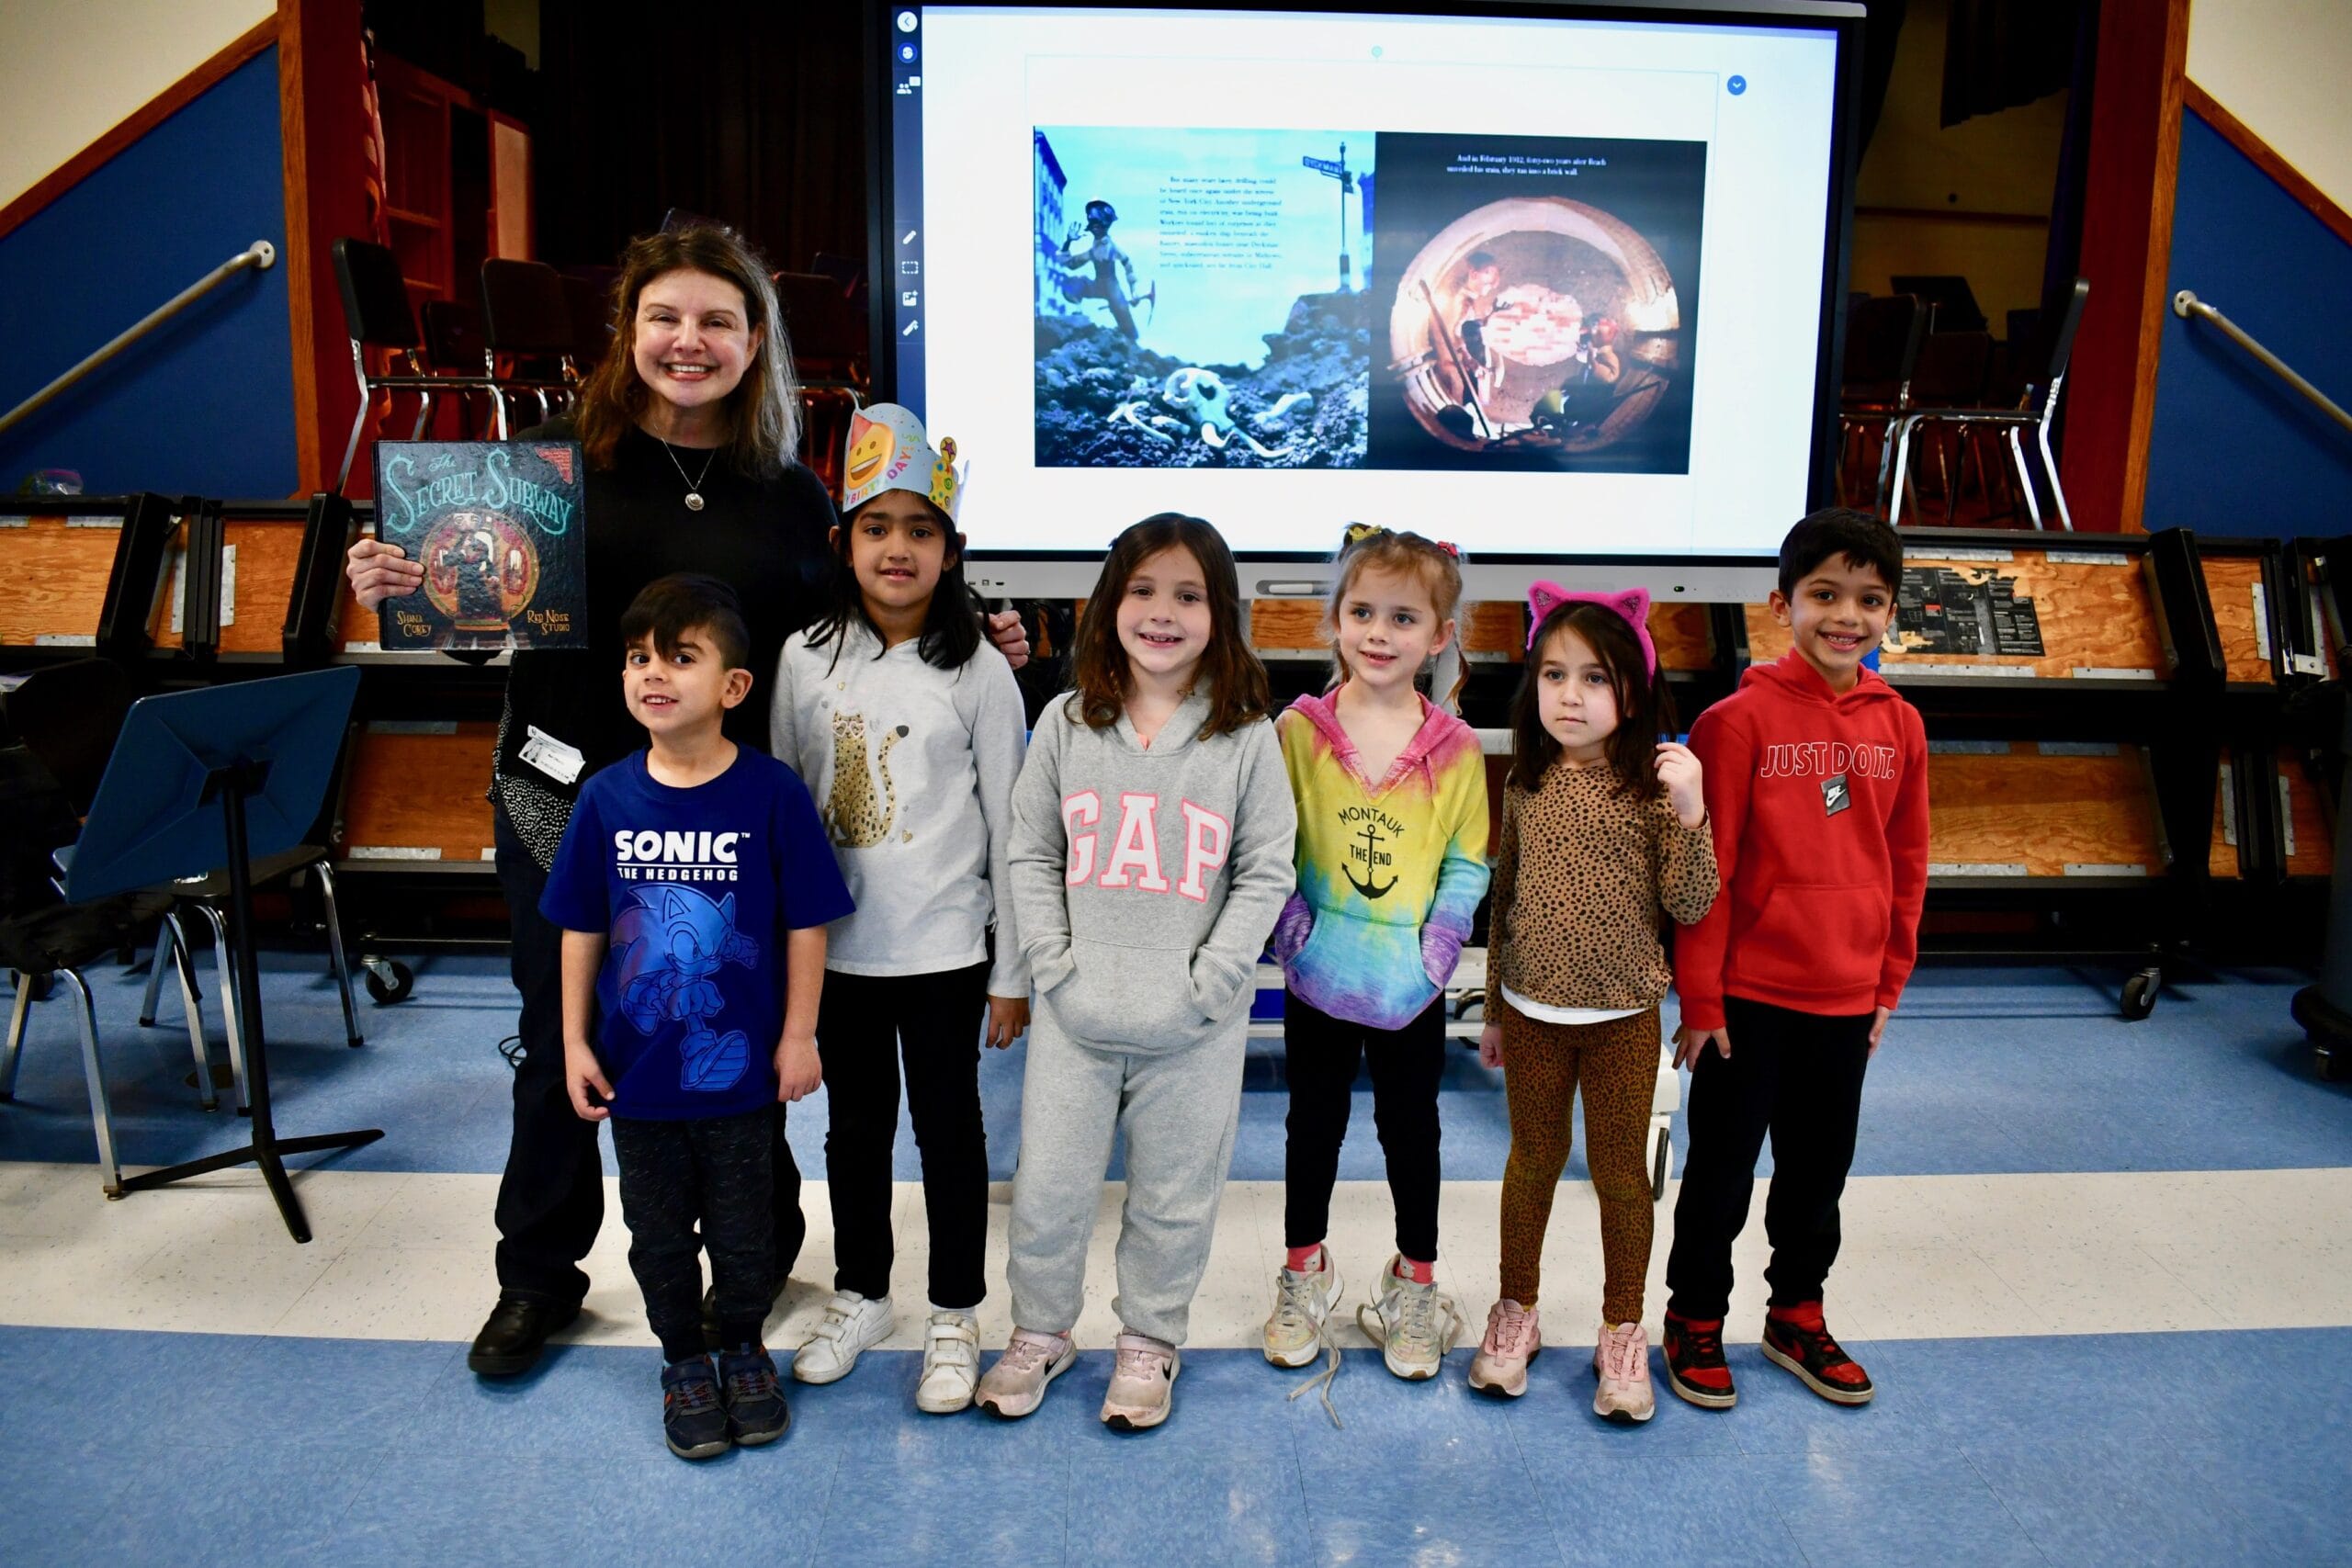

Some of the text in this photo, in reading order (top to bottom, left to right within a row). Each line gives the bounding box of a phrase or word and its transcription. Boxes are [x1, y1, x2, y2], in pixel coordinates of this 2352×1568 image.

[428, 453, 457, 472] The
[386, 446, 573, 536] SECRET SUBWAY
[541, 622, 570, 636] STUDIO
[1760, 742, 1827, 777] JUST
[1832, 742, 1872, 777] DO
[1338, 807, 1405, 838] MONTAUK
[615, 829, 739, 863] SONIC
[1061, 788, 1231, 903] GAP
[1350, 843, 1392, 866] THE END
[617, 867, 738, 882] THE HEDGEHOG
